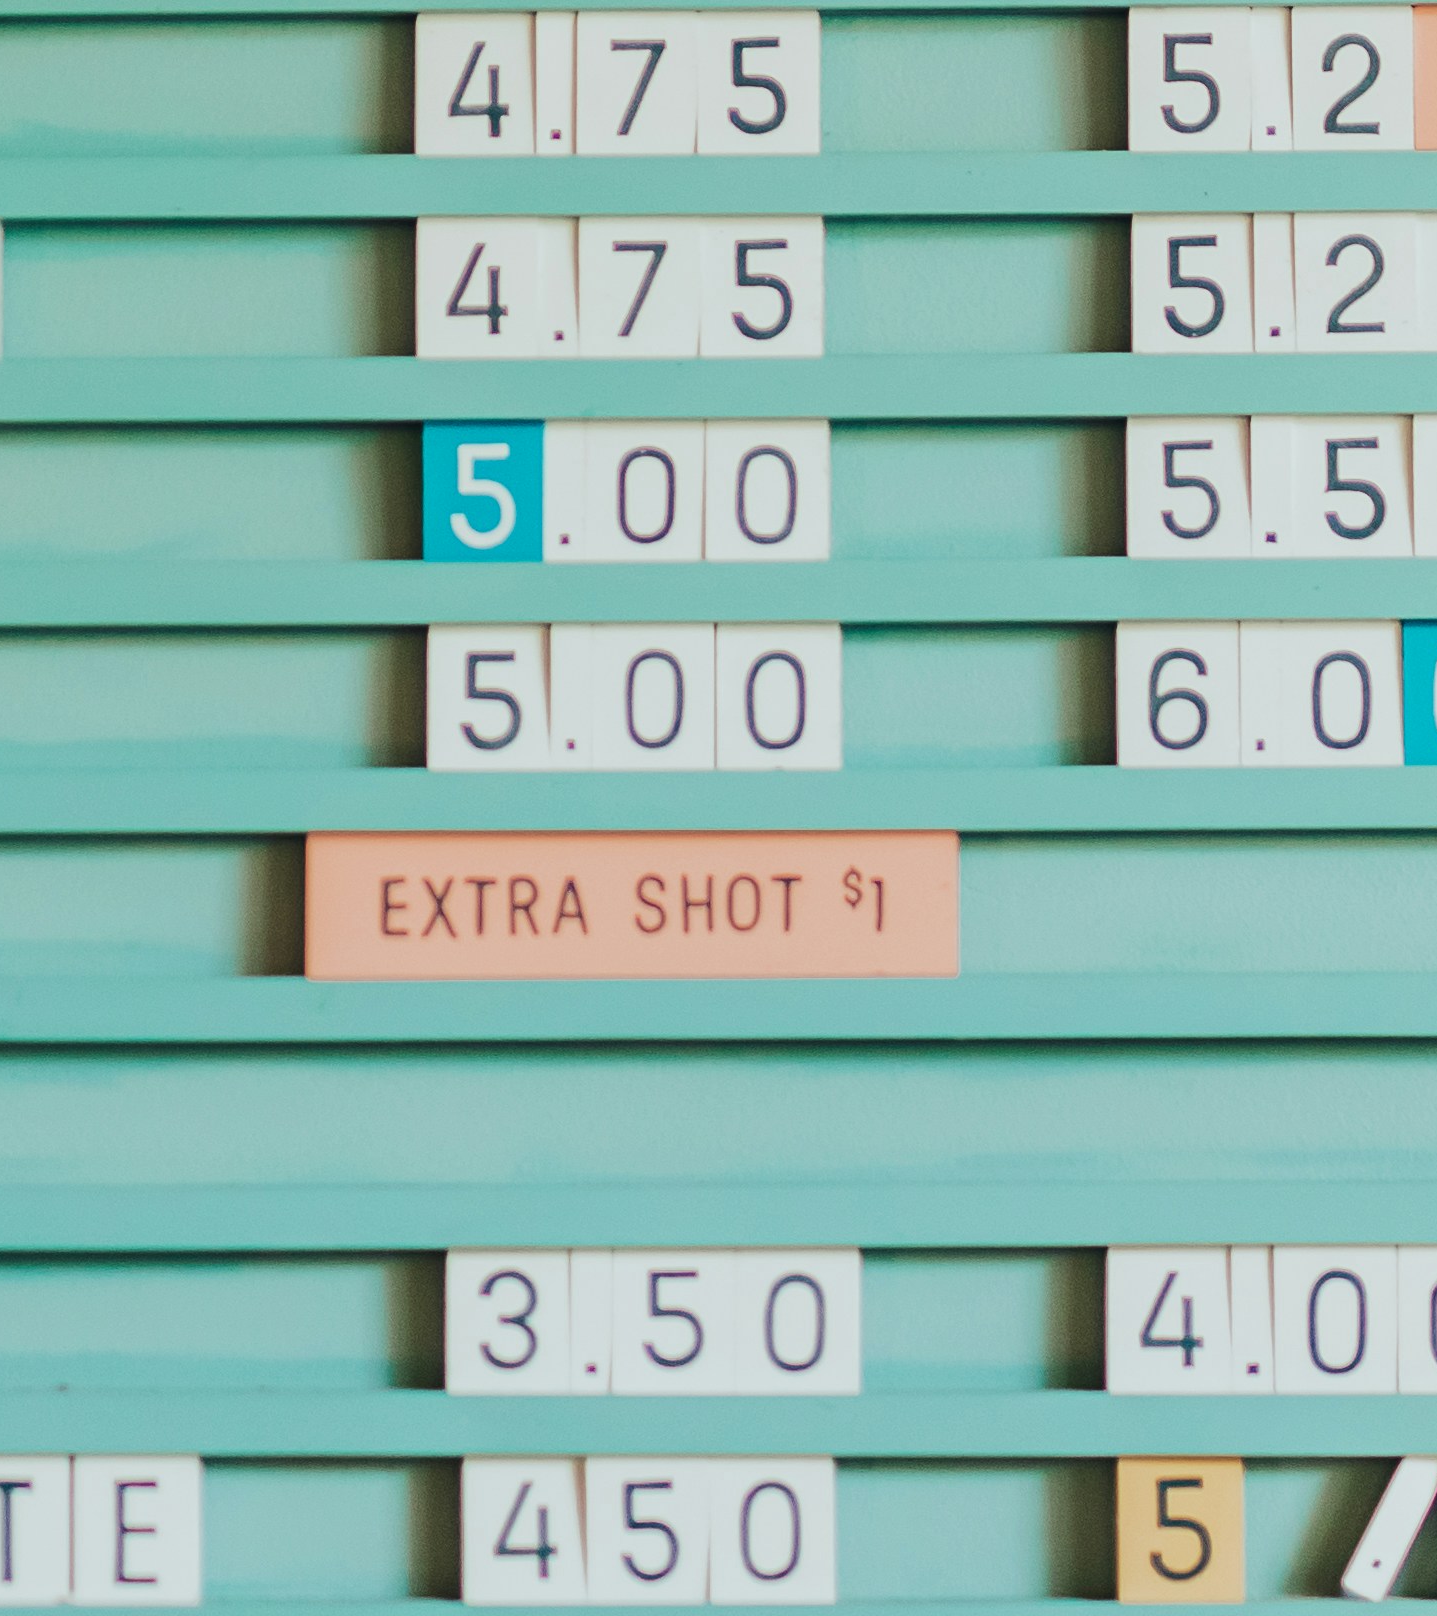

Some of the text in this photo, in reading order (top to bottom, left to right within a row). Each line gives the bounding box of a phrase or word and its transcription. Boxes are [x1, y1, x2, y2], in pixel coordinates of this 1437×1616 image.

[448, 38, 788, 140] 4.75
[446, 241, 794, 342] 4.75
[448, 442, 798, 550] 5.00
[460, 648, 806, 750] 5.00
[379, 875, 589, 938] EXTRA
[634, 873, 802, 933] SHOT
[478, 1270, 828, 1374] 3.50
